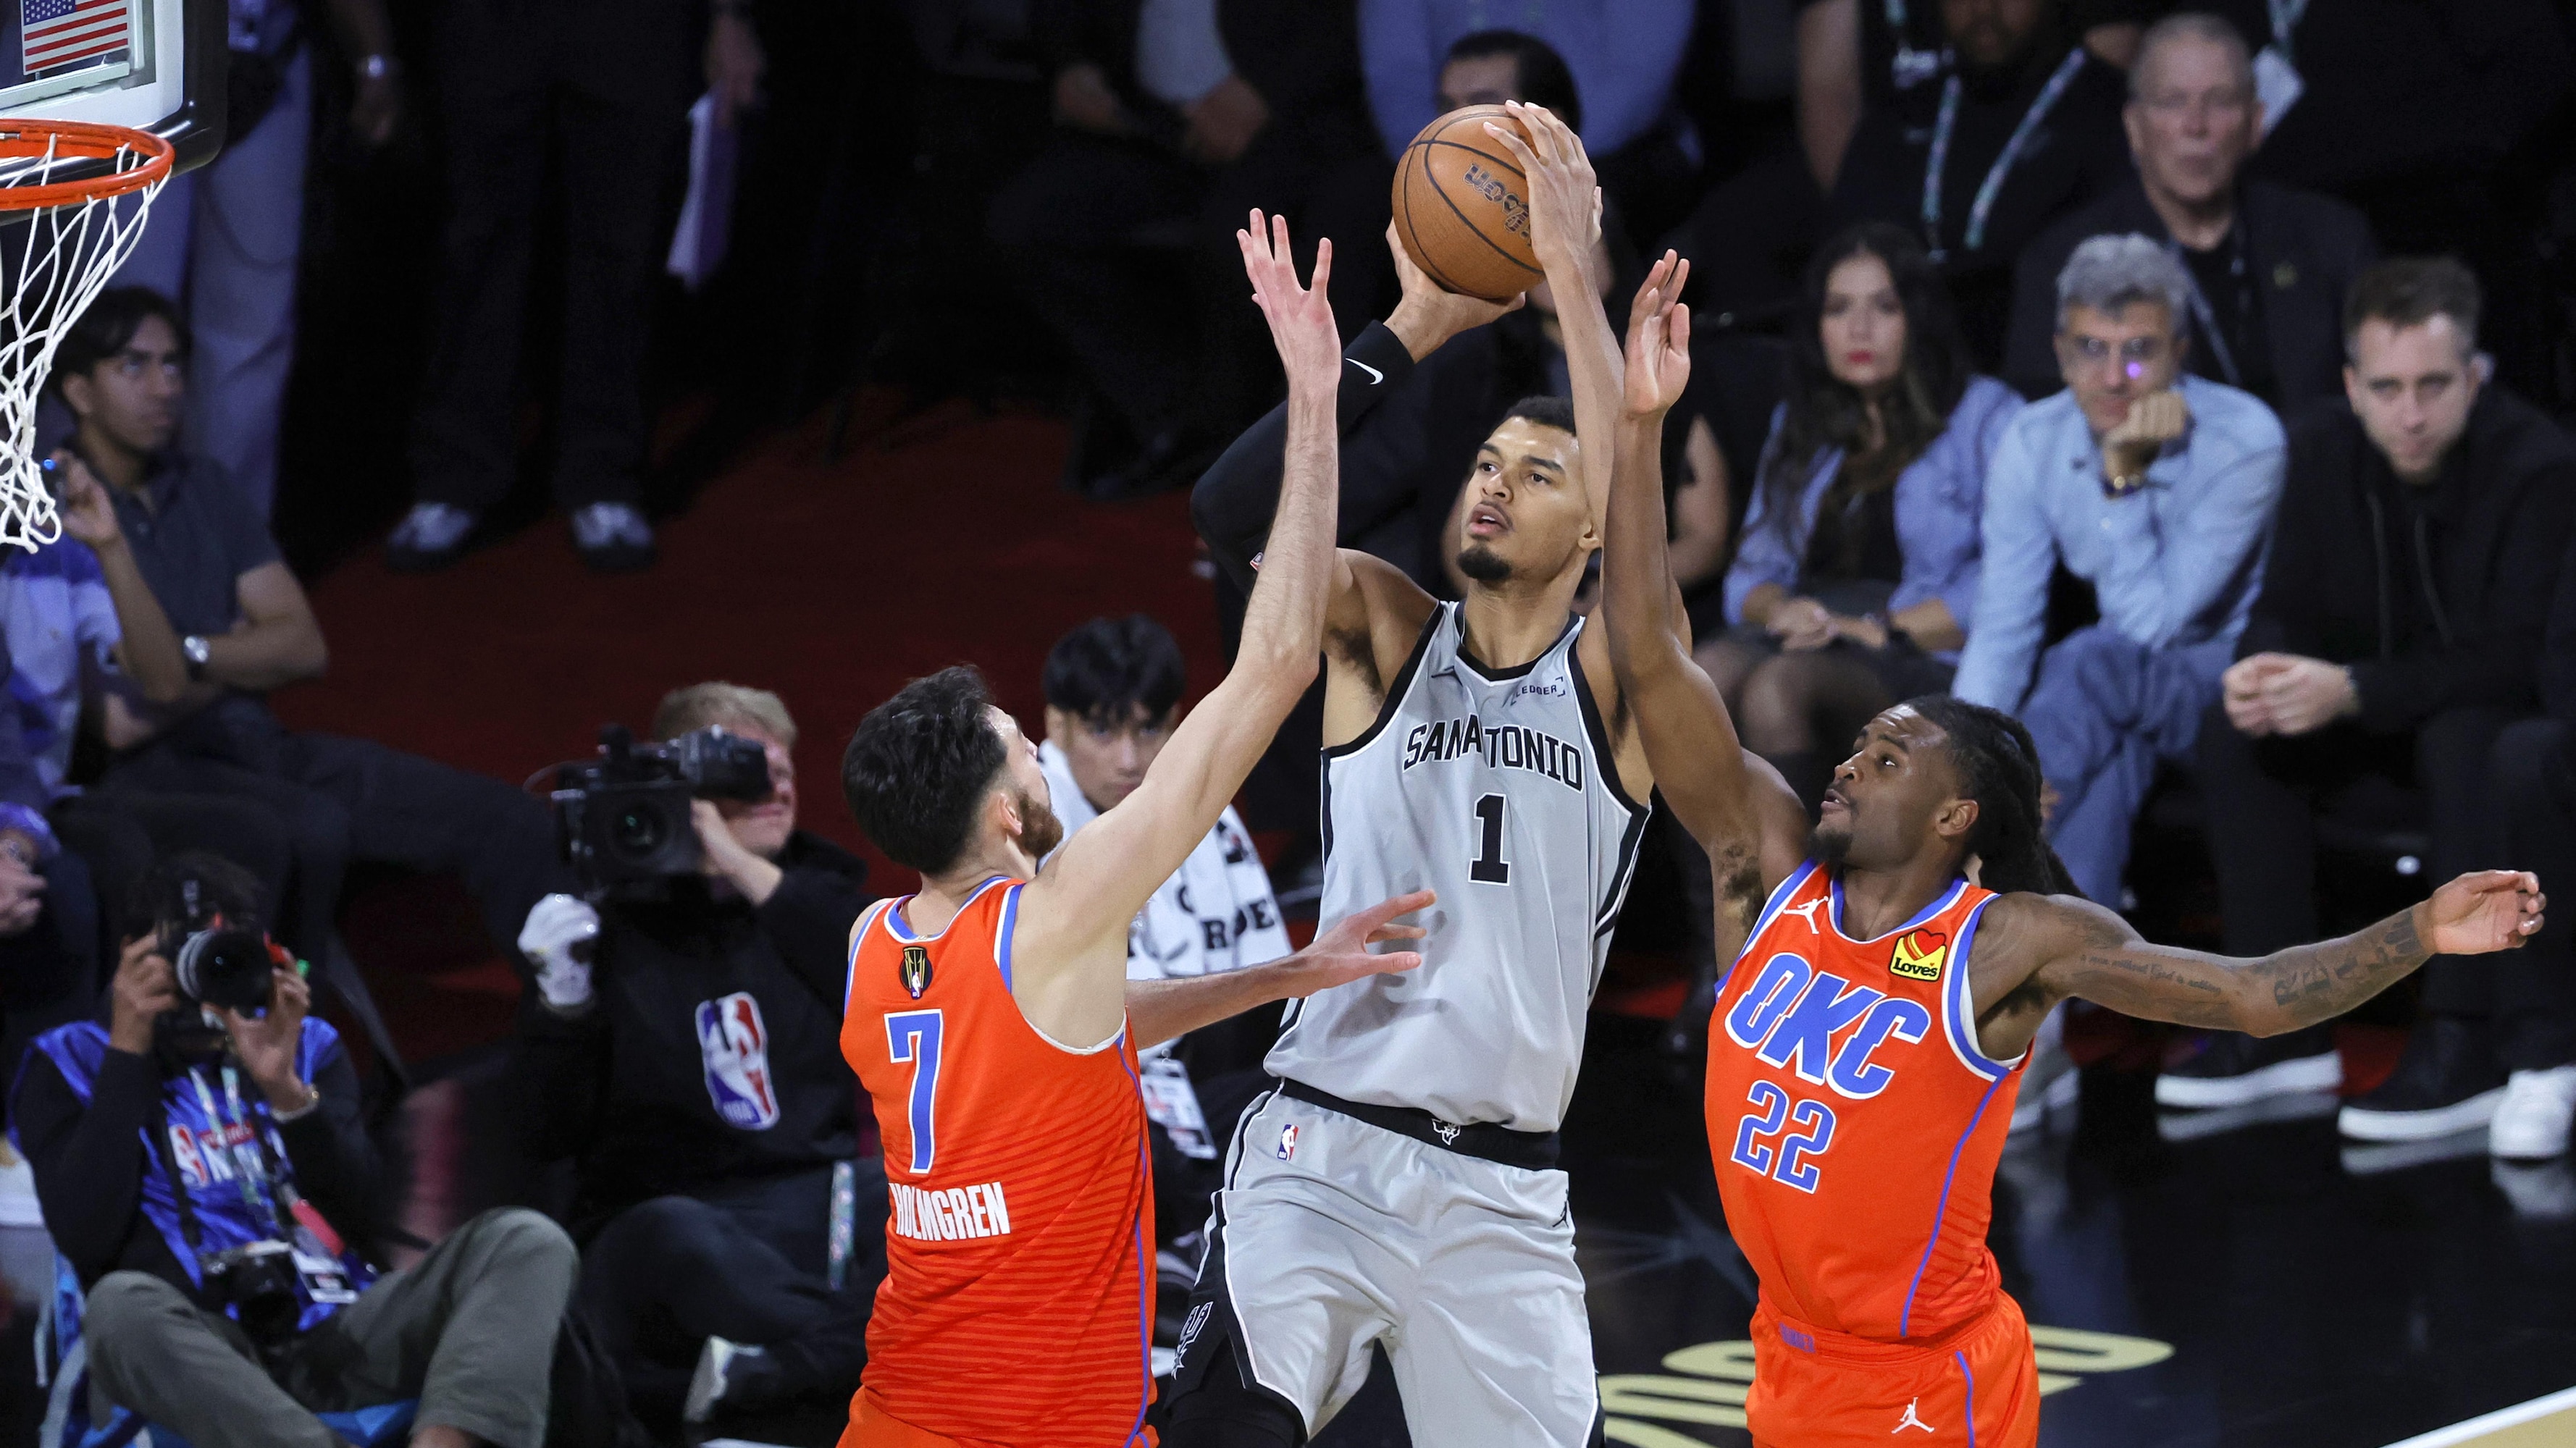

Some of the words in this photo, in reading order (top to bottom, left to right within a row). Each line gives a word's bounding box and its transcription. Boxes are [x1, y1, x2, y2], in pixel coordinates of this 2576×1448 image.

[1462, 163, 1531, 247] lson
[1461, 712, 1584, 794] ATONIO
[1468, 792, 1511, 886] 1
[1724, 951, 1931, 1100] OKC
[884, 1009, 944, 1174] 7
[1730, 1079, 1837, 1195] 22
[888, 1181, 1011, 1241] HOLMGREN
